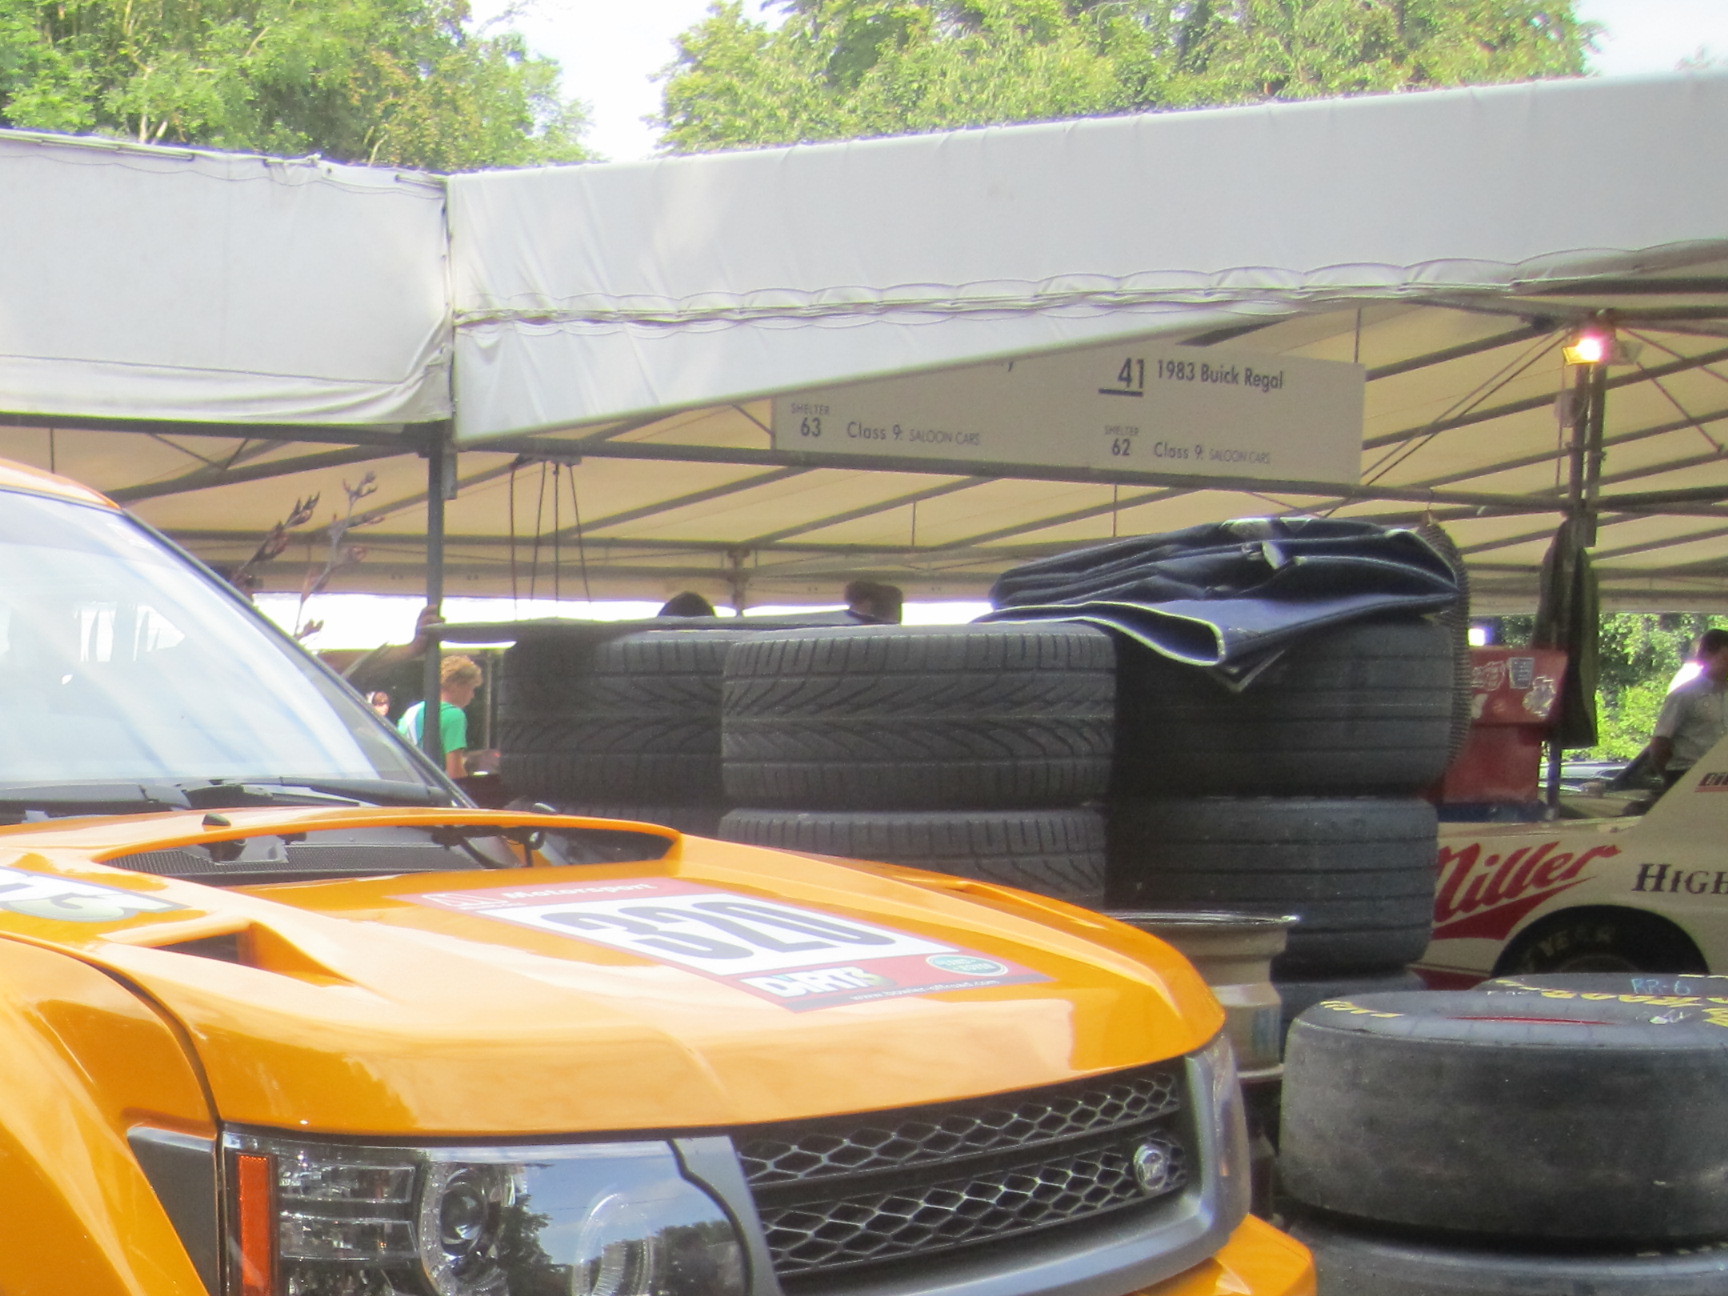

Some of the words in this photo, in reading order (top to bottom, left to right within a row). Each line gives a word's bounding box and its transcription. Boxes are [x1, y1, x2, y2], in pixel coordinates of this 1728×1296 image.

[1117, 357, 1145, 389] 41
[1157, 359, 1195, 381] 1983
[1201, 363, 1239, 386] Buick
[1244, 367, 1284, 392] Regal
[790, 403, 830, 416] SHELTER
[800, 417, 822, 438] 63
[846, 420, 887, 441] Class
[908, 428, 953, 444] SALOON
[955, 431, 980, 446] CARS
[1104, 424, 1140, 437] SHELTER
[1111, 437, 1131, 457] 62
[1153, 441, 1190, 460] Class
[1209, 448, 1248, 464] SALOON
[1250, 451, 1271, 465] CARS
[502, 882, 657, 900] Motorsport
[539, 901, 897, 960] 320
